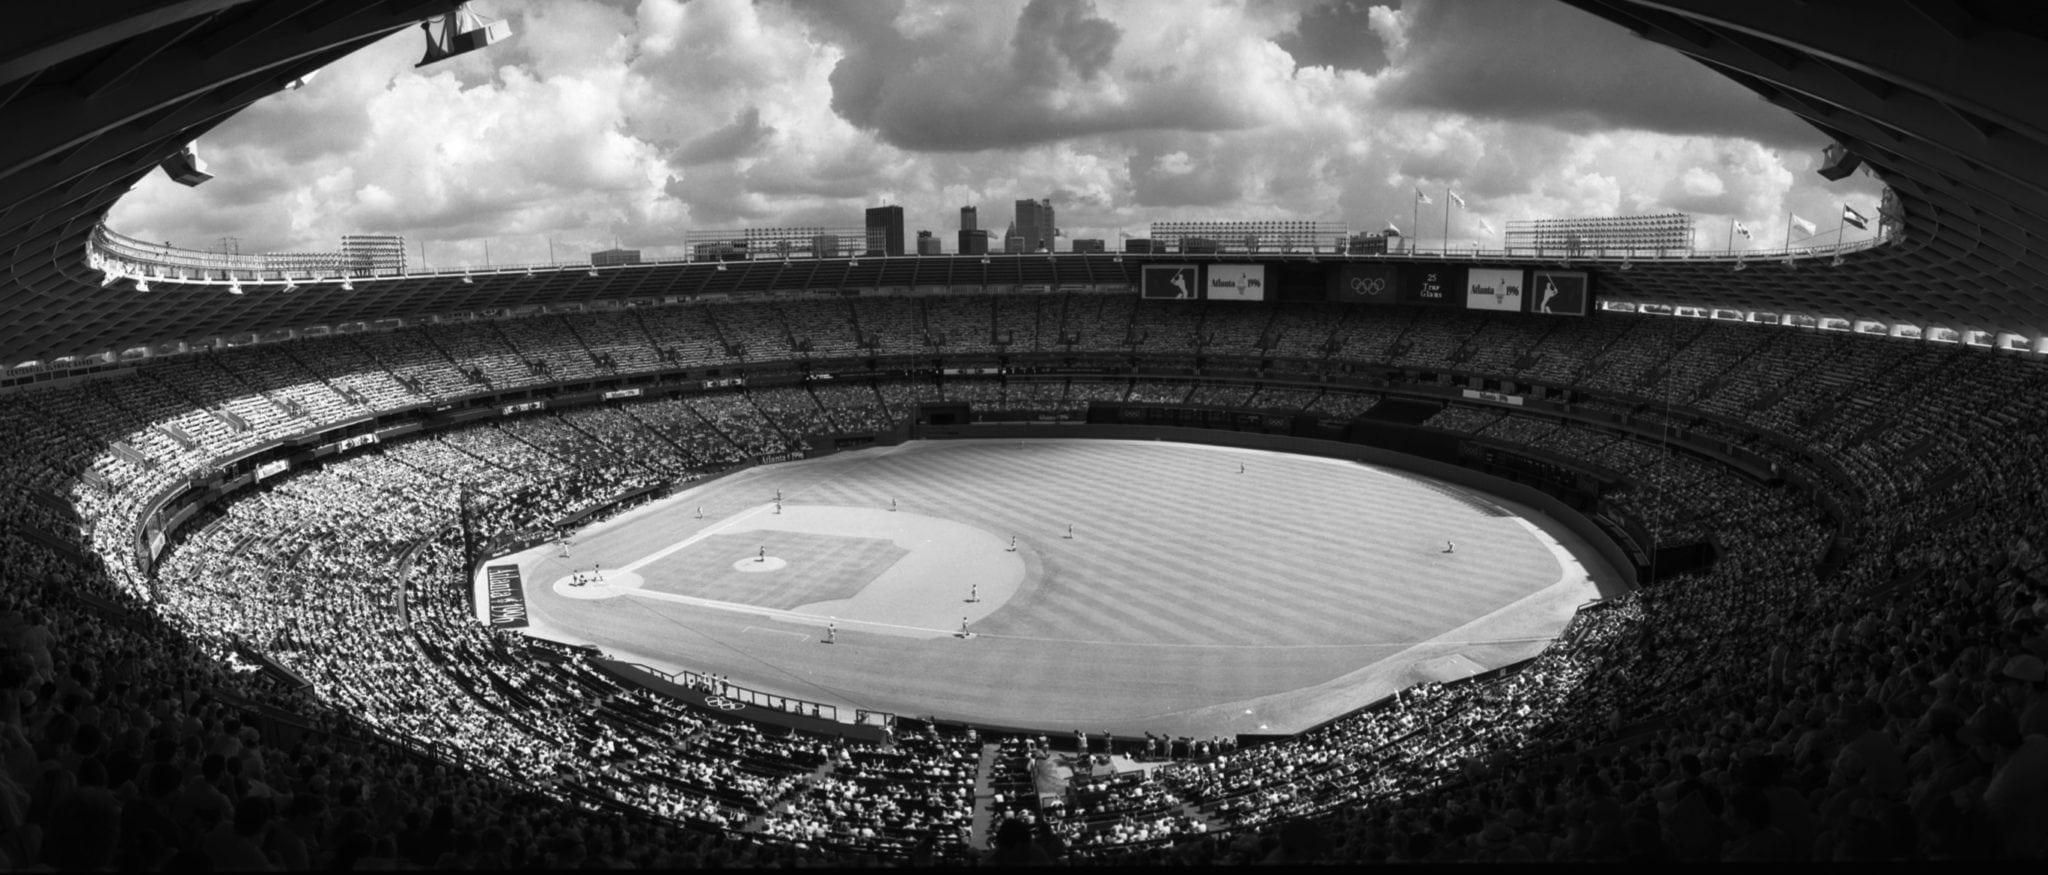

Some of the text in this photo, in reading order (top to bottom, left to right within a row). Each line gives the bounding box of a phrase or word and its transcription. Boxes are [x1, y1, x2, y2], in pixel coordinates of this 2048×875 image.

[1212, 278, 1235, 288] Atlanta
[1472, 284, 1519, 296] Atlanta 1996
[488, 569, 520, 599] Atlanta
[491, 603, 527, 624] 1996
